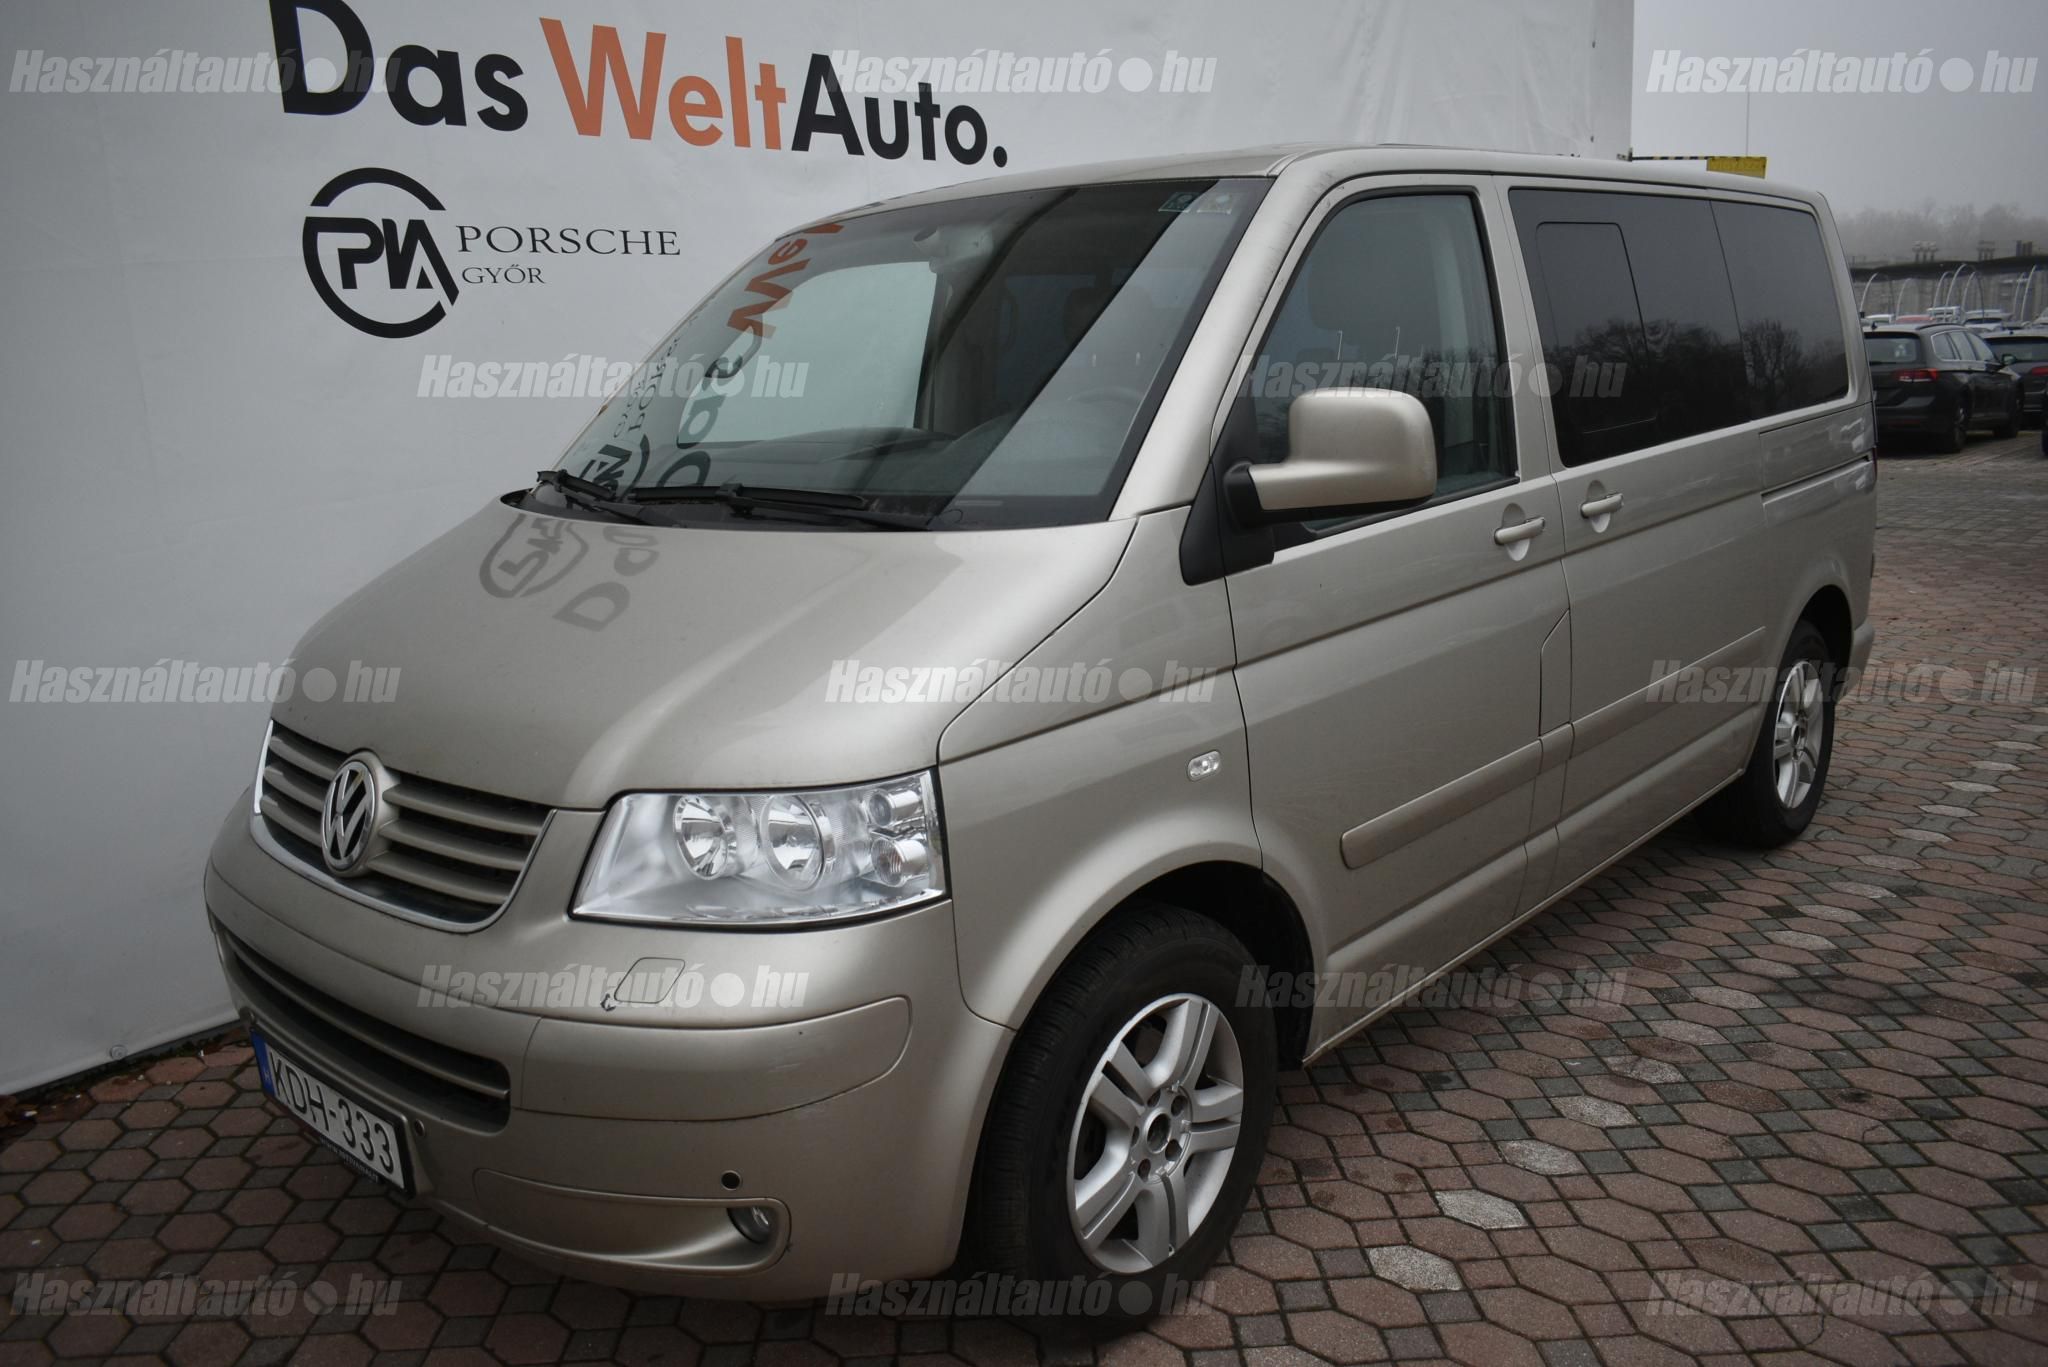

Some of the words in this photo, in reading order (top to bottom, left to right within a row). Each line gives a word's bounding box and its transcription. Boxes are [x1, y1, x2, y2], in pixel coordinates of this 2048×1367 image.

[268, 0, 529, 132] Das
[455, 224, 682, 256] PORSCHE
[461, 264, 547, 286] GYŐR
[269, 1051, 394, 1174] KDH-333
